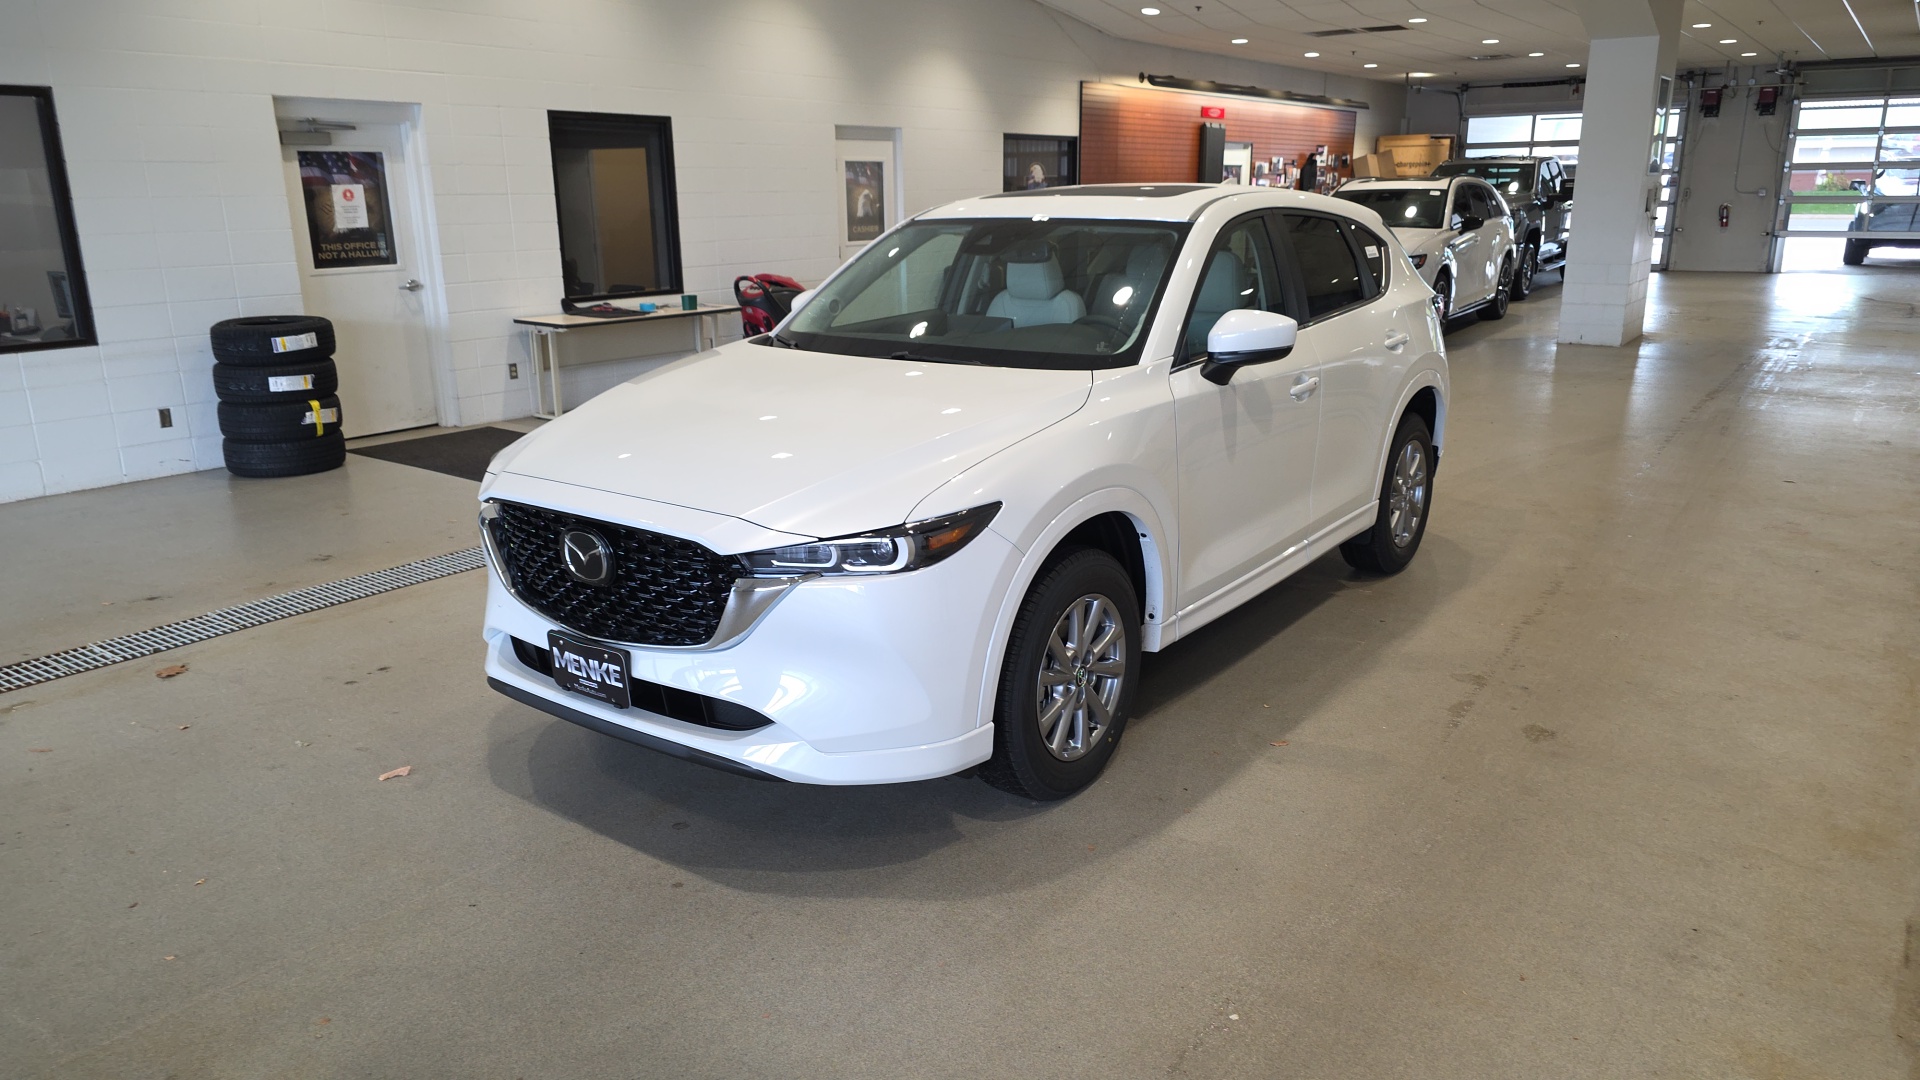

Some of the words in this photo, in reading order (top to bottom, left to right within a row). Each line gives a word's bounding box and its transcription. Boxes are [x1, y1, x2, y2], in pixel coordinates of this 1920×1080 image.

[852, 225, 879, 233] CASHIER
[320, 243, 342, 251] THIS
[344, 241, 376, 250] OFFICE
[377, 241, 386, 249] IS
[318, 251, 338, 260] NOT
[552, 646, 624, 689] MENKE
